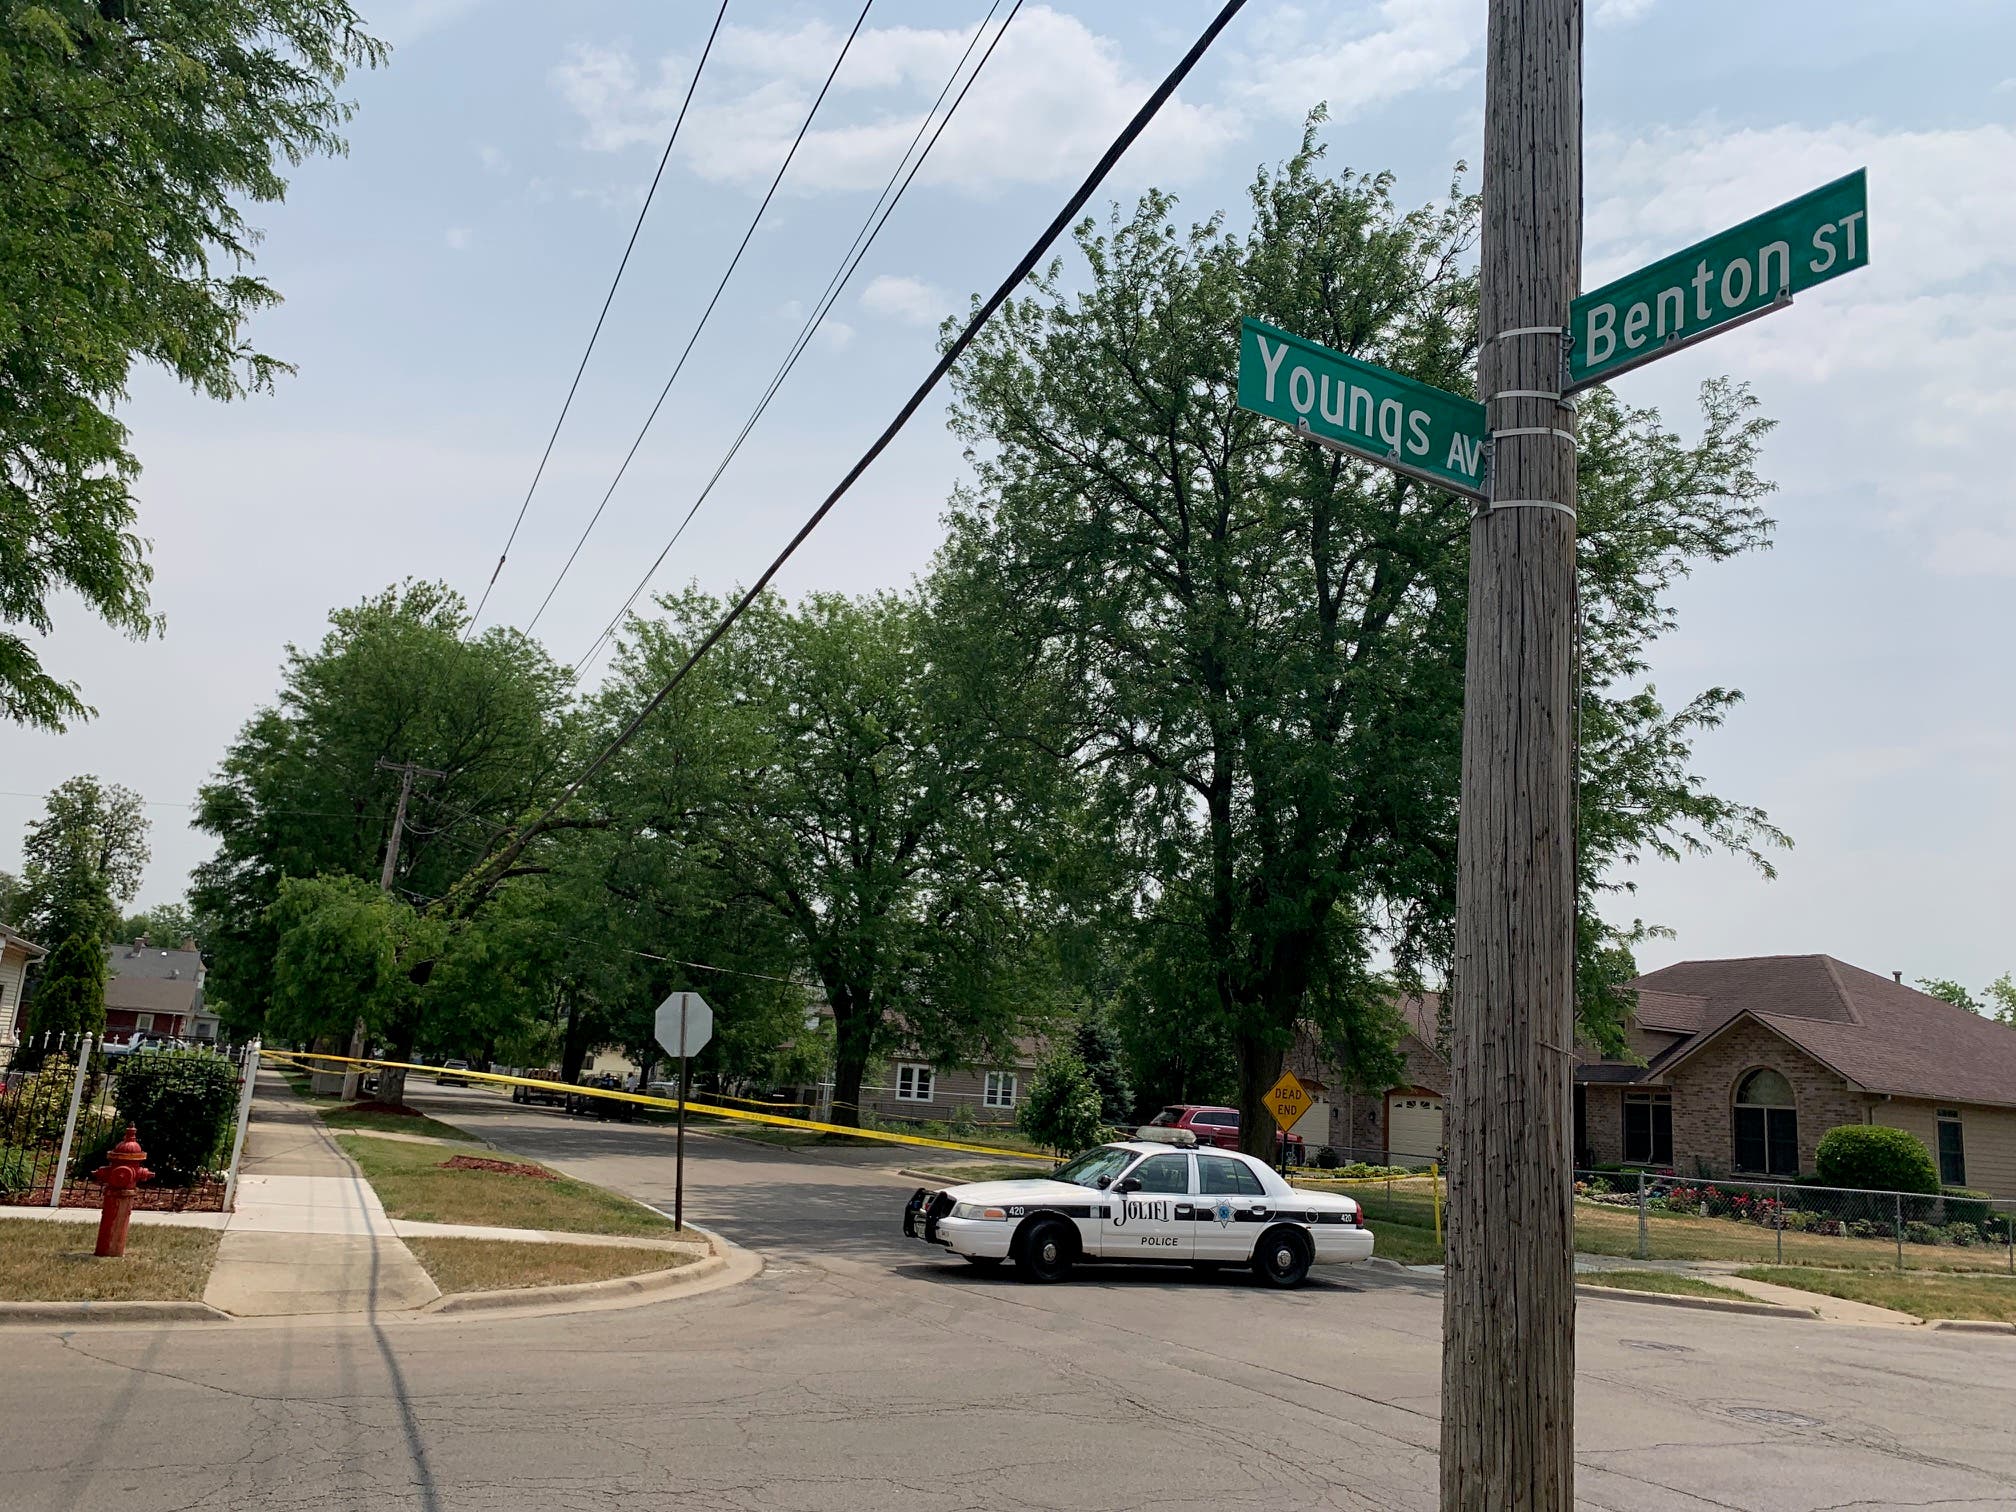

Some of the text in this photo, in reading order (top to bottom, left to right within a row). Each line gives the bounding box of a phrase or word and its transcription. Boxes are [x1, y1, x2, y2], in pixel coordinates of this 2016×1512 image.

[1586, 210, 1864, 368] Benton ST
[1256, 334, 1483, 477] Youngs AV
[1274, 1088, 1302, 1100] DEAD
[1277, 1104, 1297, 1116] END
[1008, 1206, 1025, 1216] 420
[1340, 1213, 1353, 1223] 420
[1140, 1236, 1179, 1247] POLICE
